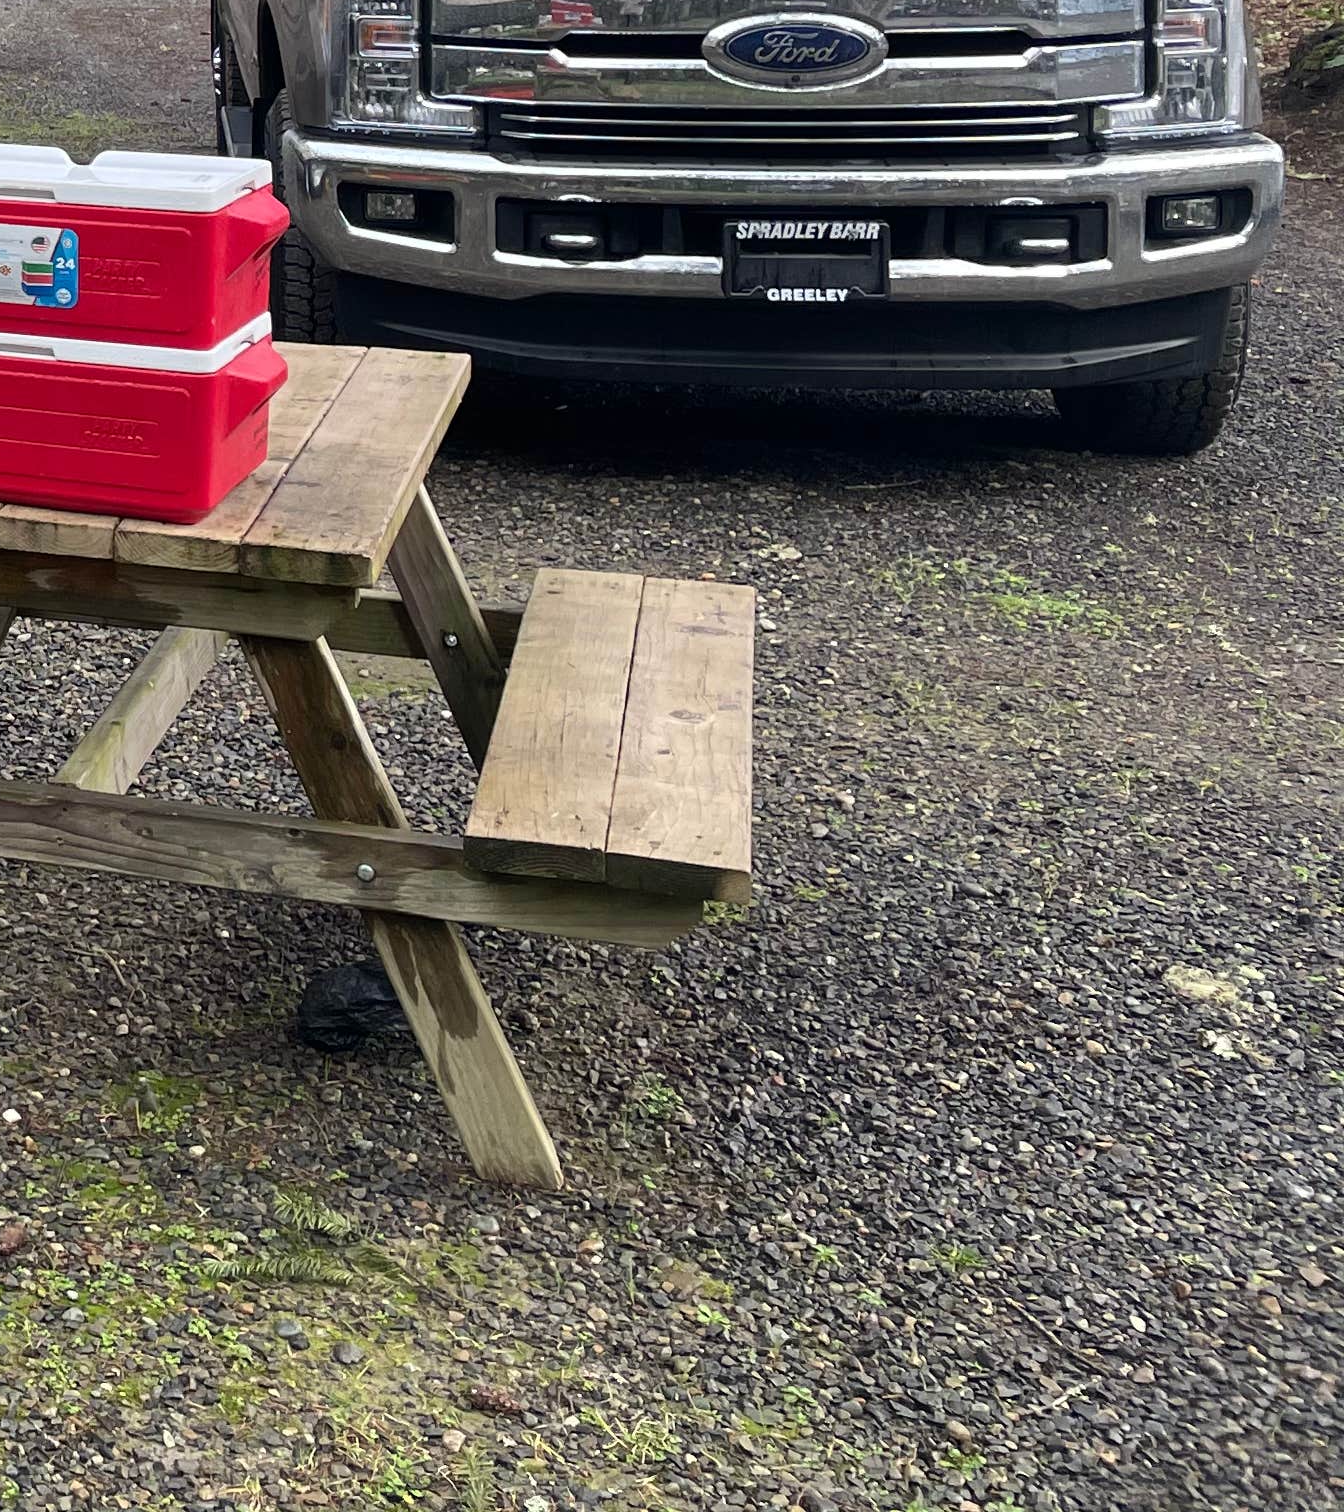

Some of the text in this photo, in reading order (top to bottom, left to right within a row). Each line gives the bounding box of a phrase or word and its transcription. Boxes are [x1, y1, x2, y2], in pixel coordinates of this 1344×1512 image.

[754, 30, 841, 64] Ford
[735, 222, 880, 240] SPRADLEY BARR
[55, 257, 75, 270] 24
[766, 288, 848, 302] GREELEY
